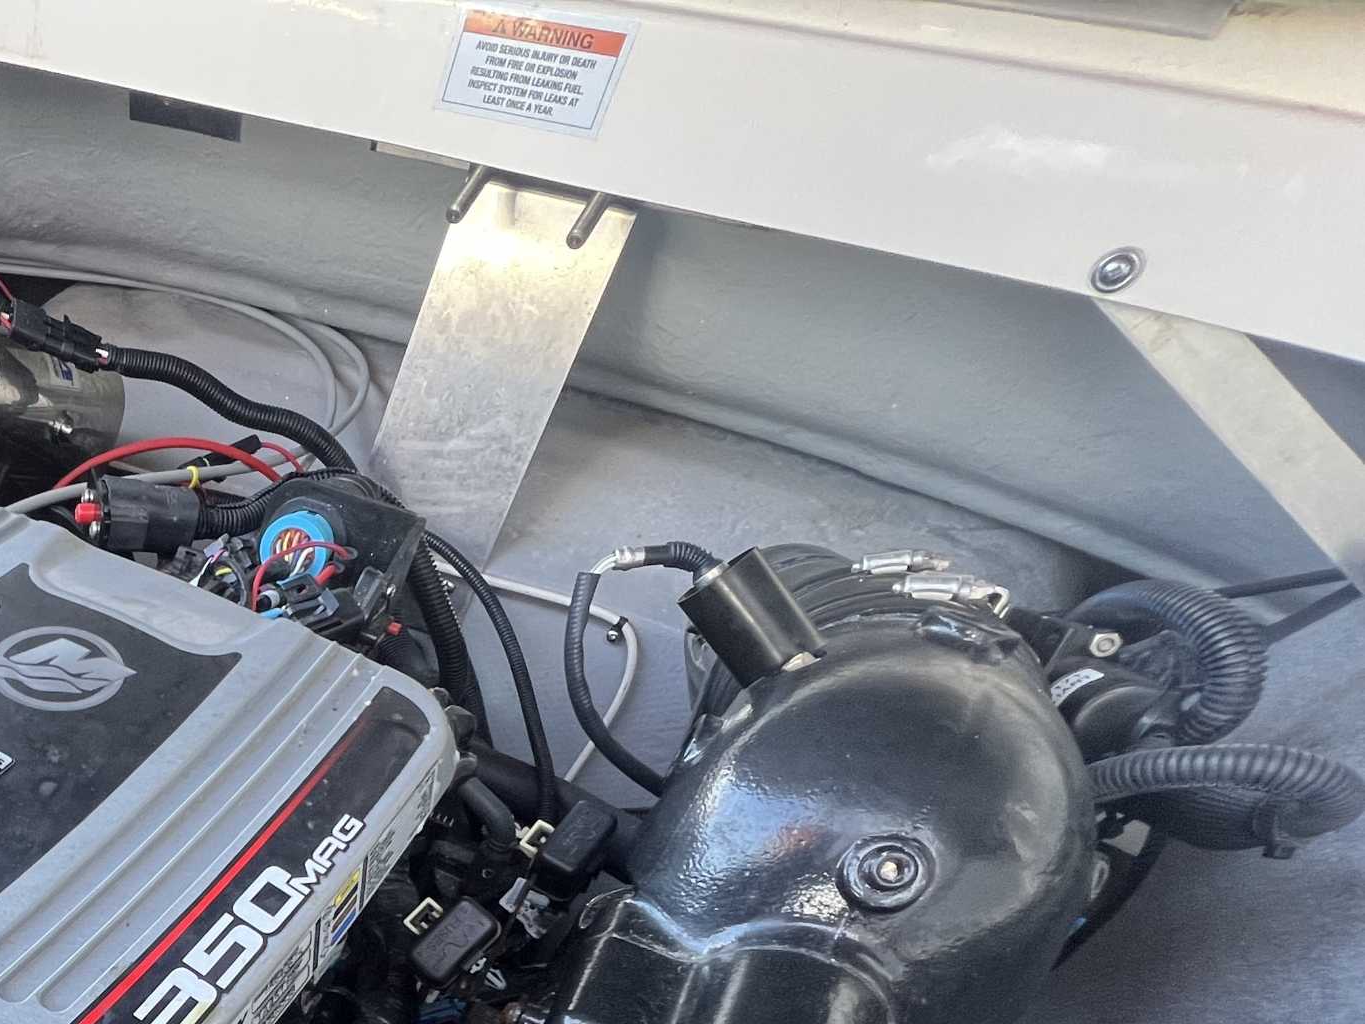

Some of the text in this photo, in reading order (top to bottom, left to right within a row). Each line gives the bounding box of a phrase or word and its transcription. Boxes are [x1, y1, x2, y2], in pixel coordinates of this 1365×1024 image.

[512, 20, 594, 49] WARNING
[476, 40, 597, 69] AVOID SERIOUS INJURY OR DEATH
[485, 55, 578, 80] FROM FIRE OR EXPLOSION
[470, 65, 509, 81] RESULTING
[510, 72, 531, 85] FROM
[531, 76, 563, 91] LEAKING
[467, 79, 580, 108] INSPECT SYSTEM FOR LEAKS AT
[483, 94, 505, 107] LEAST
[506, 98, 525, 111] ONCE
[289, 813, 364, 896] MAG
